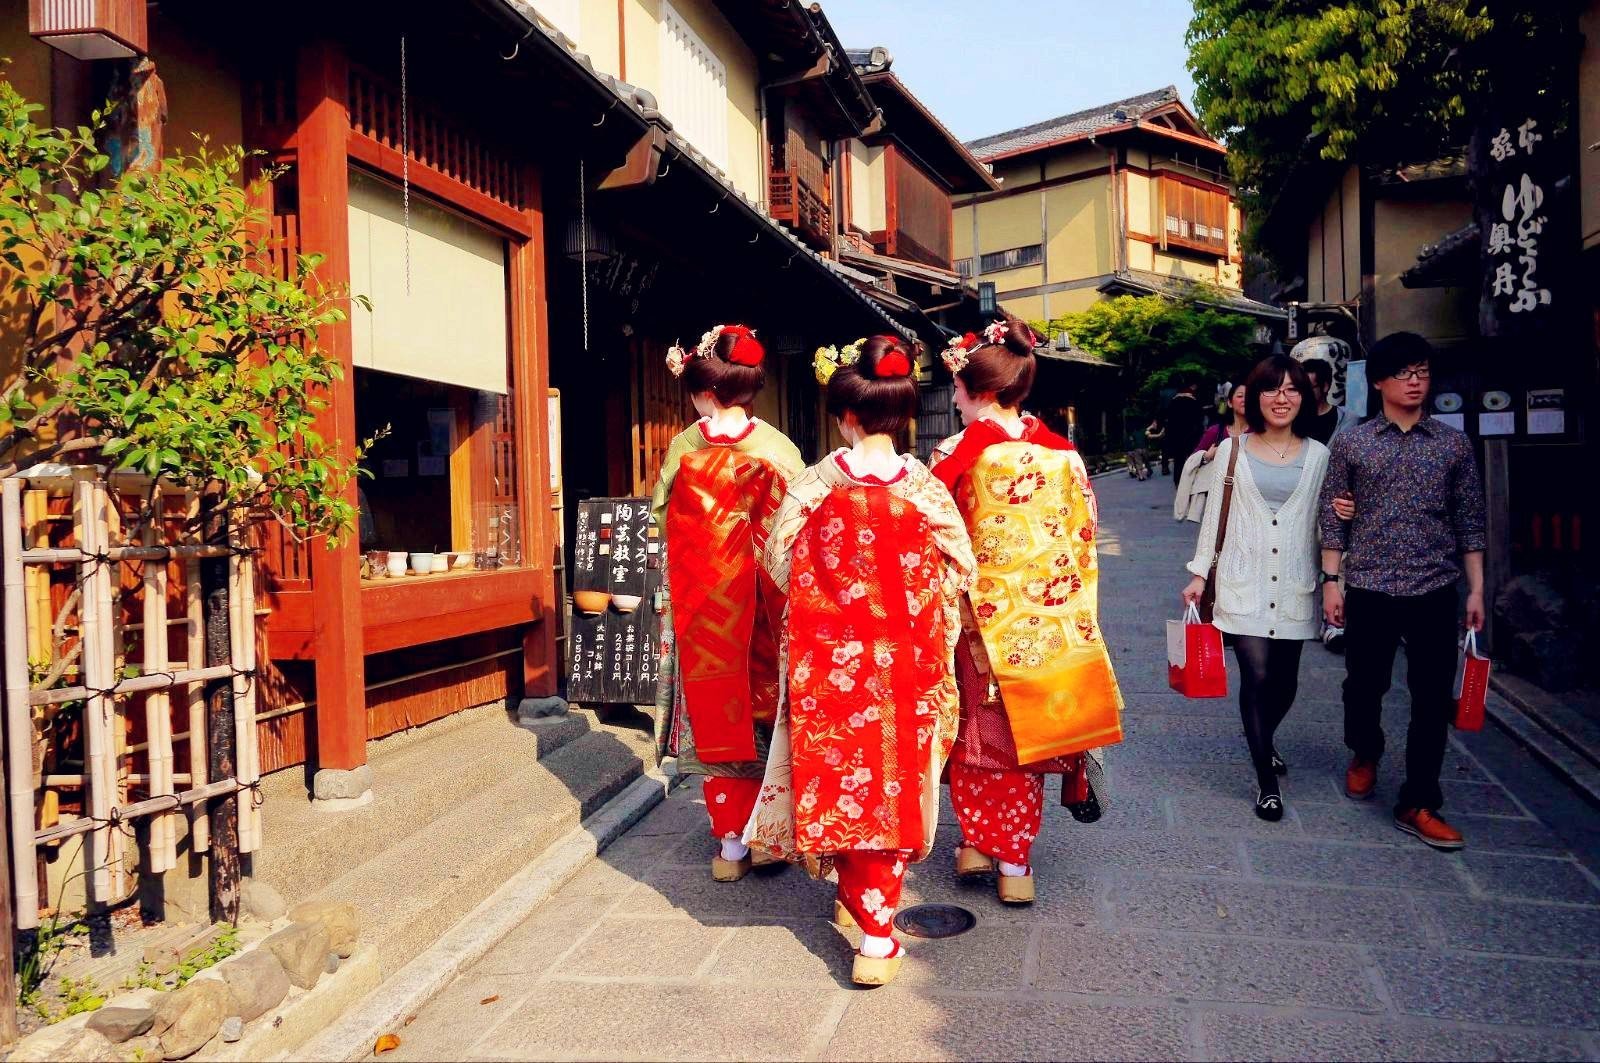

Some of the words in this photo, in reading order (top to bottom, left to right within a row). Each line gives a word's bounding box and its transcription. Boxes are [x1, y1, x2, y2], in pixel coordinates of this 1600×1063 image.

[612, 504, 633, 583] 陶芸教室
[634, 505, 650, 574] ろくろの
[572, 634, 583, 682] 3500円
[585, 650, 595, 679] コース
[612, 633, 623, 681] 2200円
[641, 633, 650, 682] 1800円
